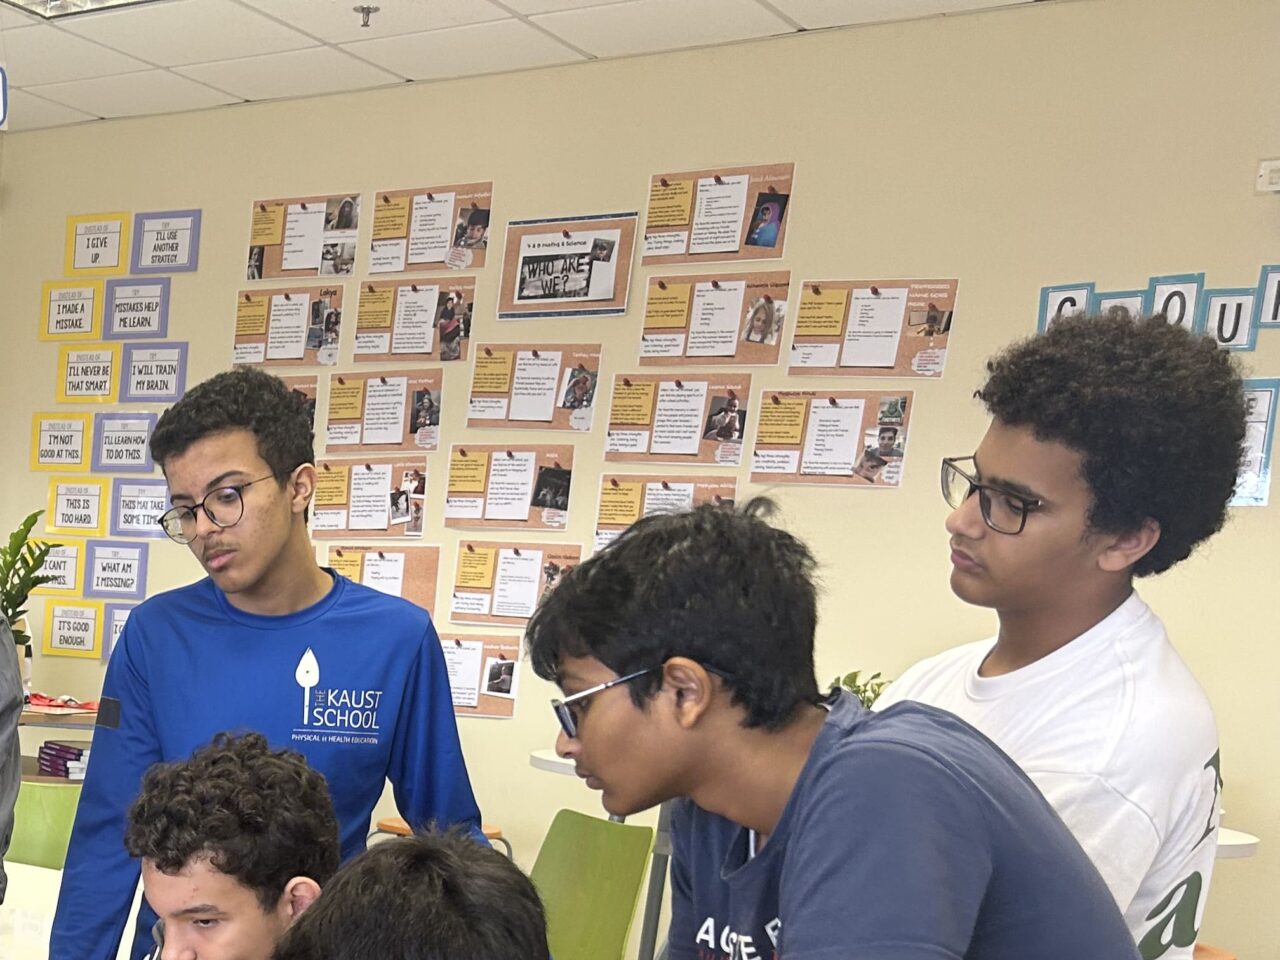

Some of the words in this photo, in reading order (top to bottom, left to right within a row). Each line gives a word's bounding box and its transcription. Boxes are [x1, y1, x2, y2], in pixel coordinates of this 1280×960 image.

[167, 231, 177, 240] USE
[87, 238, 90, 249] I
[91, 237, 108, 248] GIVE
[153, 243, 179, 252] ANOTHER
[91, 253, 100, 264] UP.
[527, 261, 554, 278] WHO
[561, 256, 585, 274] ARE
[541, 275, 570, 295] WE?
[57, 305, 61, 314] I
[62, 303, 79, 314] MADE
[80, 303, 84, 313] A
[115, 302, 143, 313] MISTAKES
[144, 302, 159, 311] HELP
[56, 318, 84, 330] MISTAKE.
[119, 317, 128, 328] ME
[129, 317, 152, 328] LEARN.
[81, 366, 100, 376] NEVER
[102, 365, 109, 376] BE
[133, 365, 136, 375] I
[138, 365, 153, 376] WILL
[155, 364, 176, 375] TRAIN
[68, 381, 83, 391] THAT
[136, 380, 145, 390] MY
[147, 380, 169, 391] BRAIN.
[60, 434, 73, 445] NOT
[114, 435, 132, 445] LEARN
[132, 435, 145, 445] HOW
[40, 449, 55, 459] GOOD
[57, 449, 64, 458] AT
[106, 449, 114, 459] TO
[115, 449, 124, 460] DO
[66, 499, 81, 509] THIS
[82, 499, 90, 509] IS
[122, 499, 136, 509] THIS
[137, 499, 149, 510] MAY
[151, 499, 164, 510] TAKE
[61, 513, 74, 523] TOO
[123, 514, 140, 524] SOME
[44, 559, 47, 570] I
[49, 560, 66, 570] CAN'T
[101, 563, 120, 573] WHAT
[121, 563, 132, 573] AM
[96, 577, 100, 587] I
[101, 577, 134, 588] MISSING?
[58, 621, 71, 631] IT'S
[72, 622, 89, 632] GOOD
[328, 689, 383, 708] KAUST
[313, 708, 379, 729] SCHOOL
[329, 735, 350, 743] HEALTH
[352, 736, 378, 744] EDUCATION
